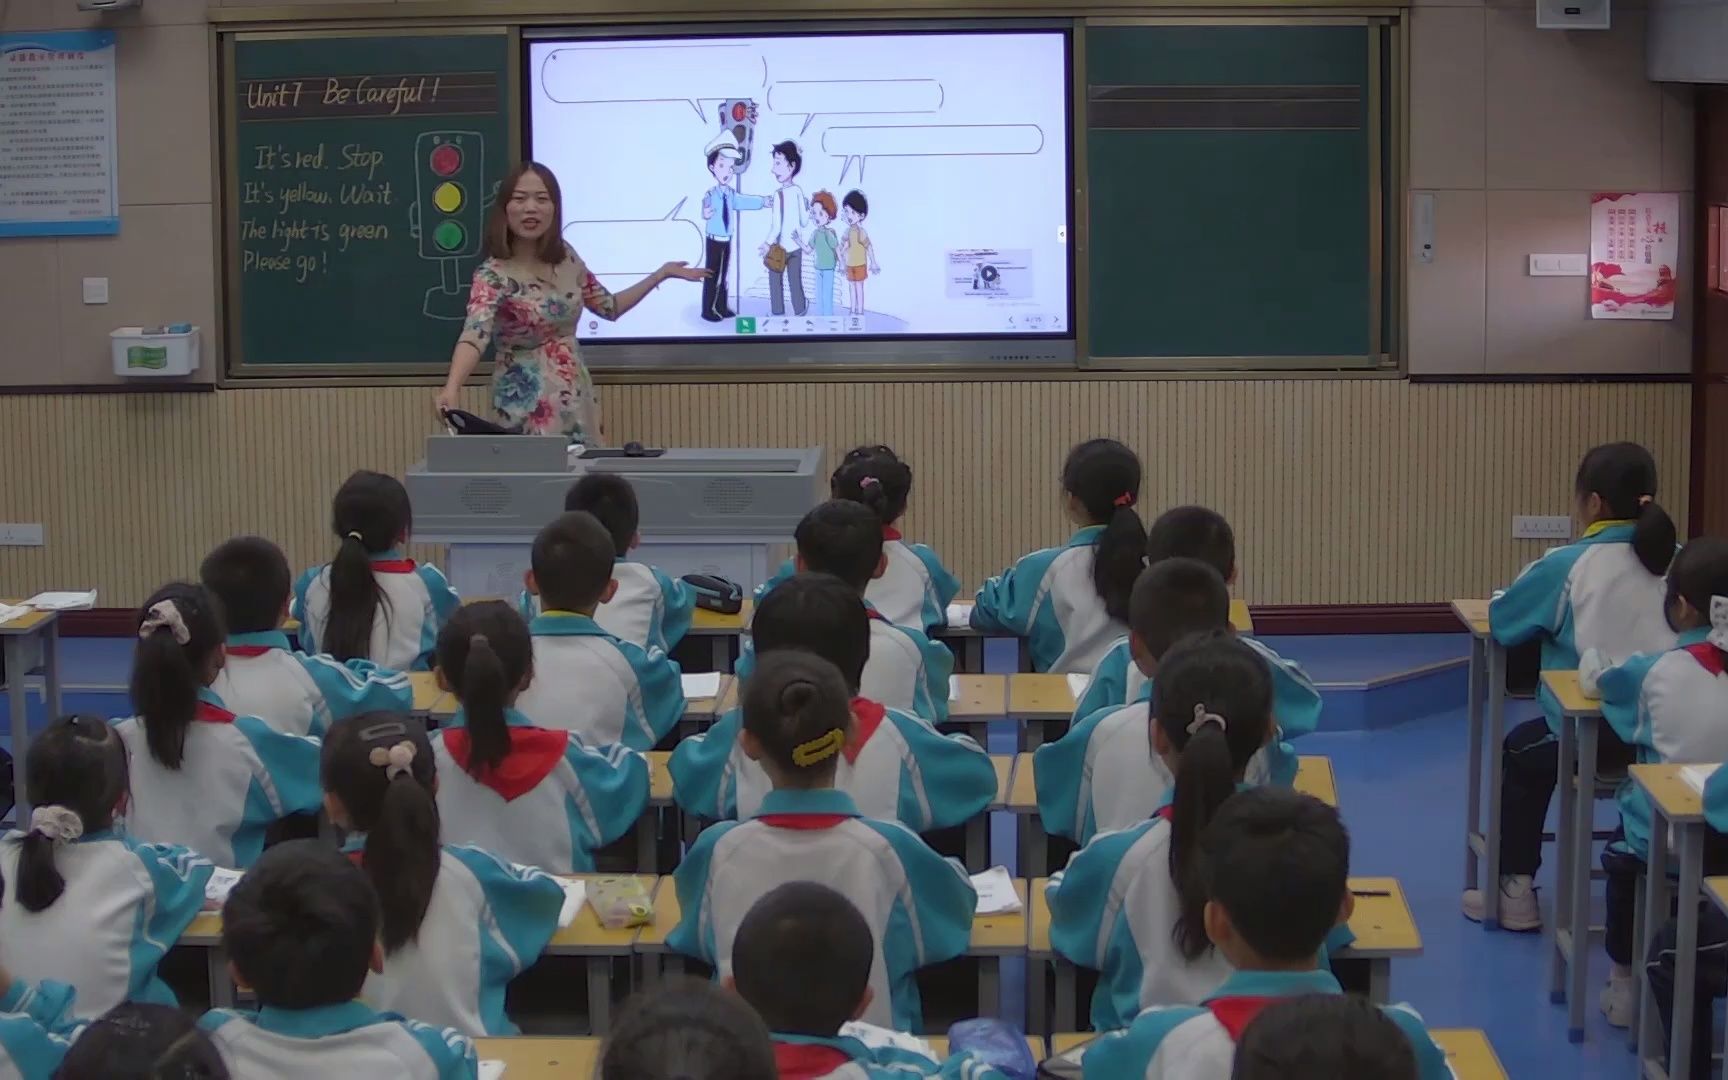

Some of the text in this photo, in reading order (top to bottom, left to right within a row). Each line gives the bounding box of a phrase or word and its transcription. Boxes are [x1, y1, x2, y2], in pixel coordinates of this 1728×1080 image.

[247, 82, 288, 109] Unit
[322, 78, 351, 105] Be
[254, 144, 291, 170] It's
[337, 144, 384, 180] Stop
[243, 181, 274, 204] It's
[340, 181, 392, 205] Wait
[241, 217, 389, 252] The light is green
[243, 250, 291, 272] Please
